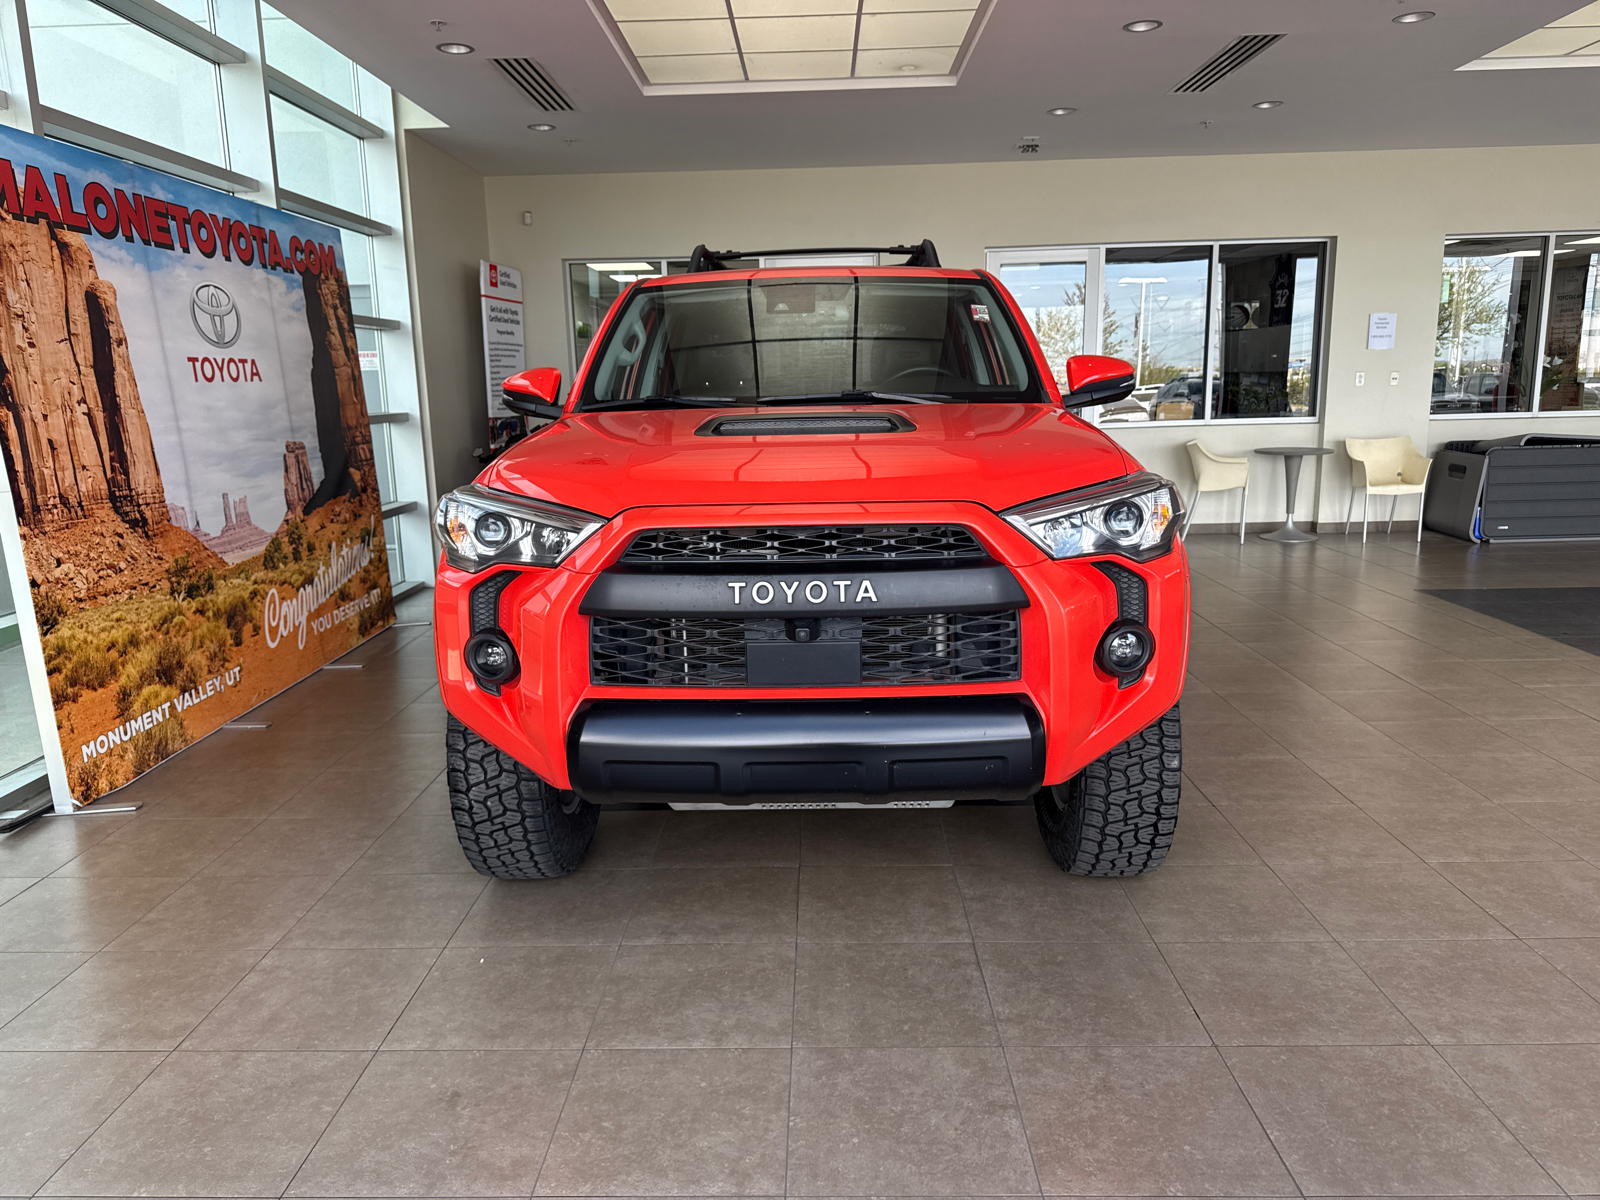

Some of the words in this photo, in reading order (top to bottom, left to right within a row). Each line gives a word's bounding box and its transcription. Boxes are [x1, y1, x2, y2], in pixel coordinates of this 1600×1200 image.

[1274, 289, 1289, 308] 32
[186, 356, 263, 384] TOYOTA
[264, 514, 374, 650] Congratulations!
[728, 580, 878, 604] TOYOTA
[311, 612, 332, 635] YOU
[333, 594, 370, 625] DESERVE
[81, 702, 171, 763] MONUMENT
[173, 676, 225, 713] VALLEY,
[225, 666, 241, 686] UT
